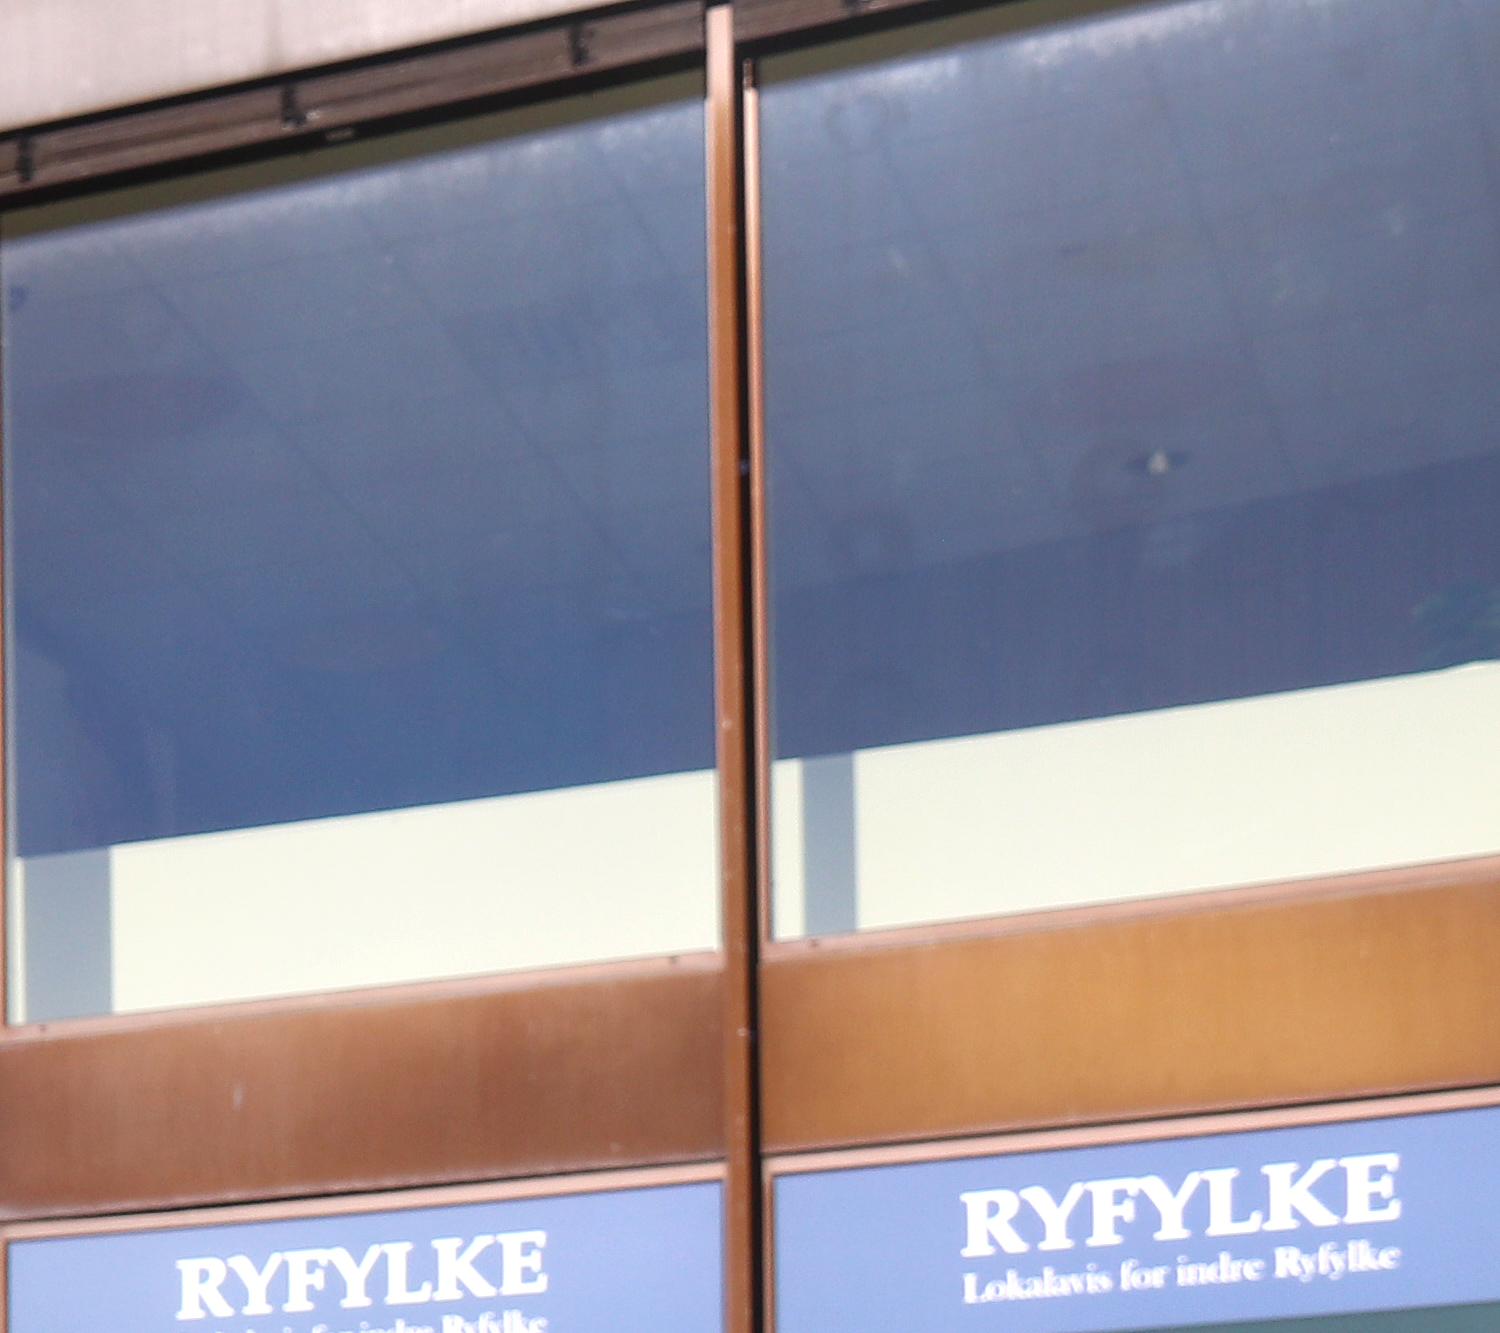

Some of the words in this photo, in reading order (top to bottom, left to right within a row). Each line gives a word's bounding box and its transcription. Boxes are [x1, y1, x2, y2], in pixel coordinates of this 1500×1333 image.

[958, 1152, 1402, 1259] RYFYLKE
[174, 1230, 549, 1321] RYFYLKE
[963, 1263, 1114, 1304] Lokalavis
[1120, 1258, 1171, 1292] for
[1176, 1251, 1265, 1287] indre
[1274, 1238, 1402, 1283] Ryfylke
